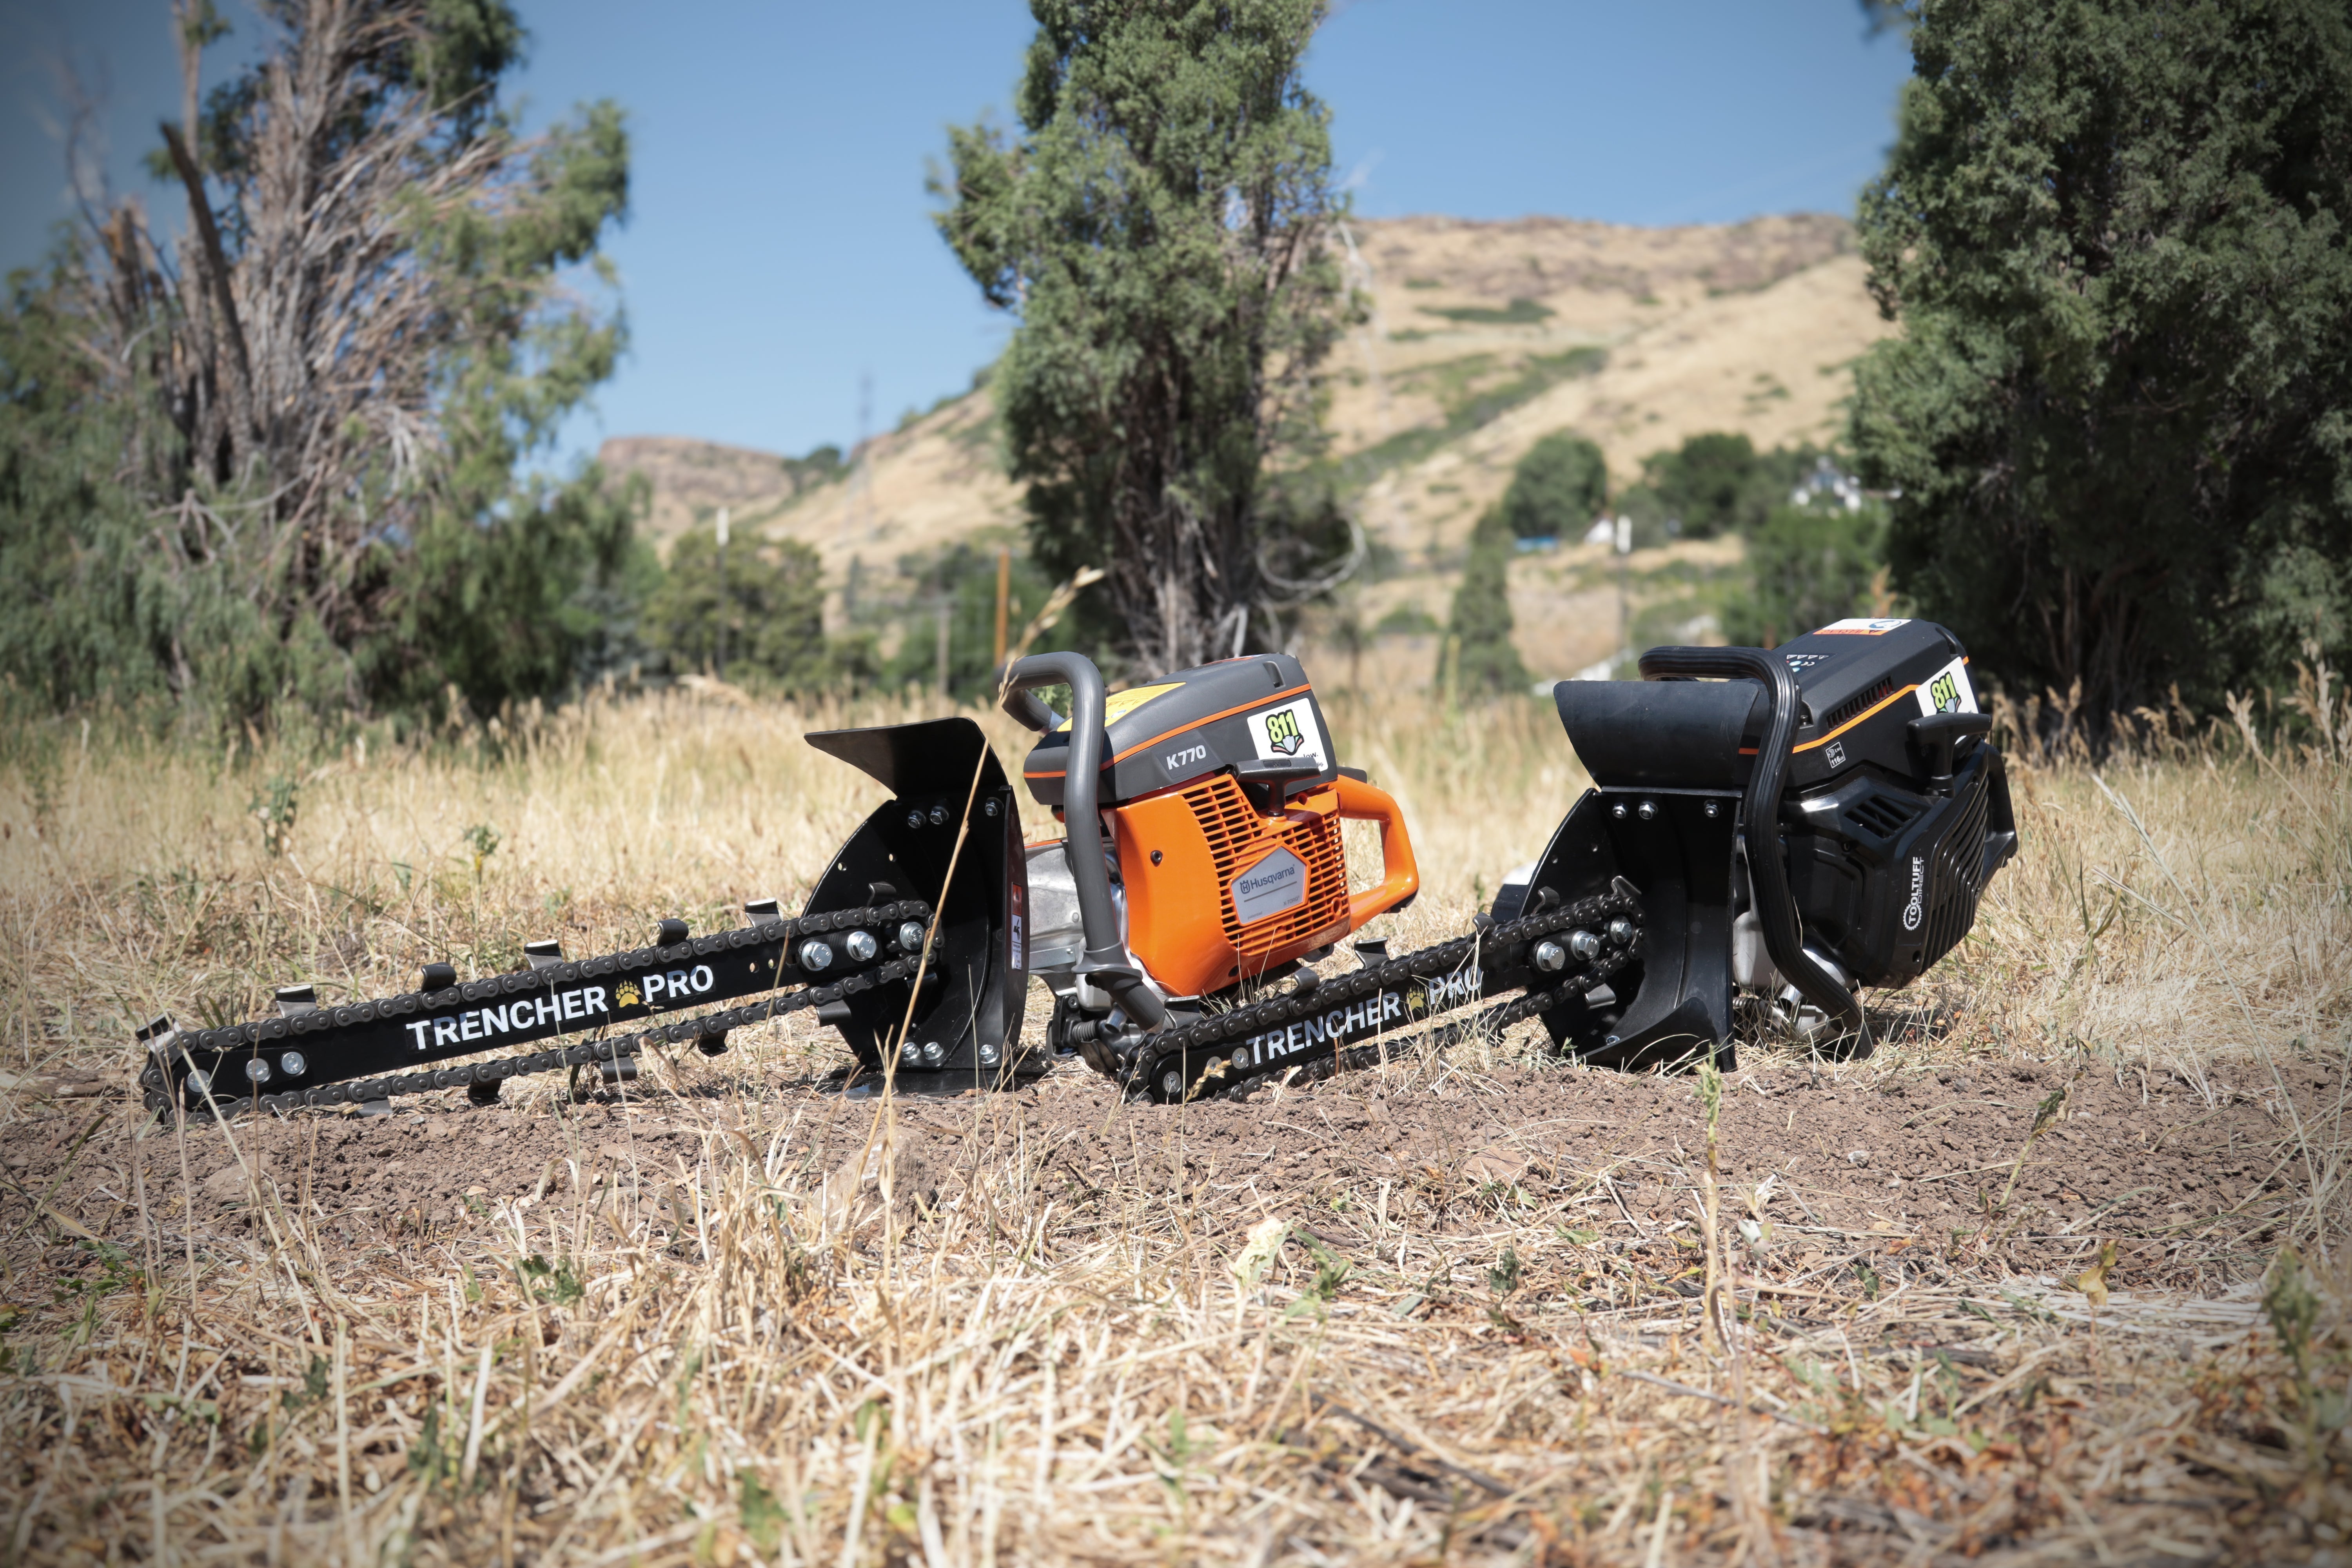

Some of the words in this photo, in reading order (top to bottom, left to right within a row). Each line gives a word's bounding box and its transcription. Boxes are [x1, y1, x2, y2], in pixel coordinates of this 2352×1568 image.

[1931, 672, 1957, 709] 811
[1266, 709, 1299, 743] 811
[1167, 745, 1206, 770] K770
[1250, 866, 1295, 889] Husqvarna
[1908, 857, 1920, 924] TOOLTUFF
[406, 986, 609, 1050] TRENCHER
[643, 965, 713, 1002] PRO
[1246, 992, 1401, 1064] TRENCHER
[1428, 965, 1482, 1005] PRO
